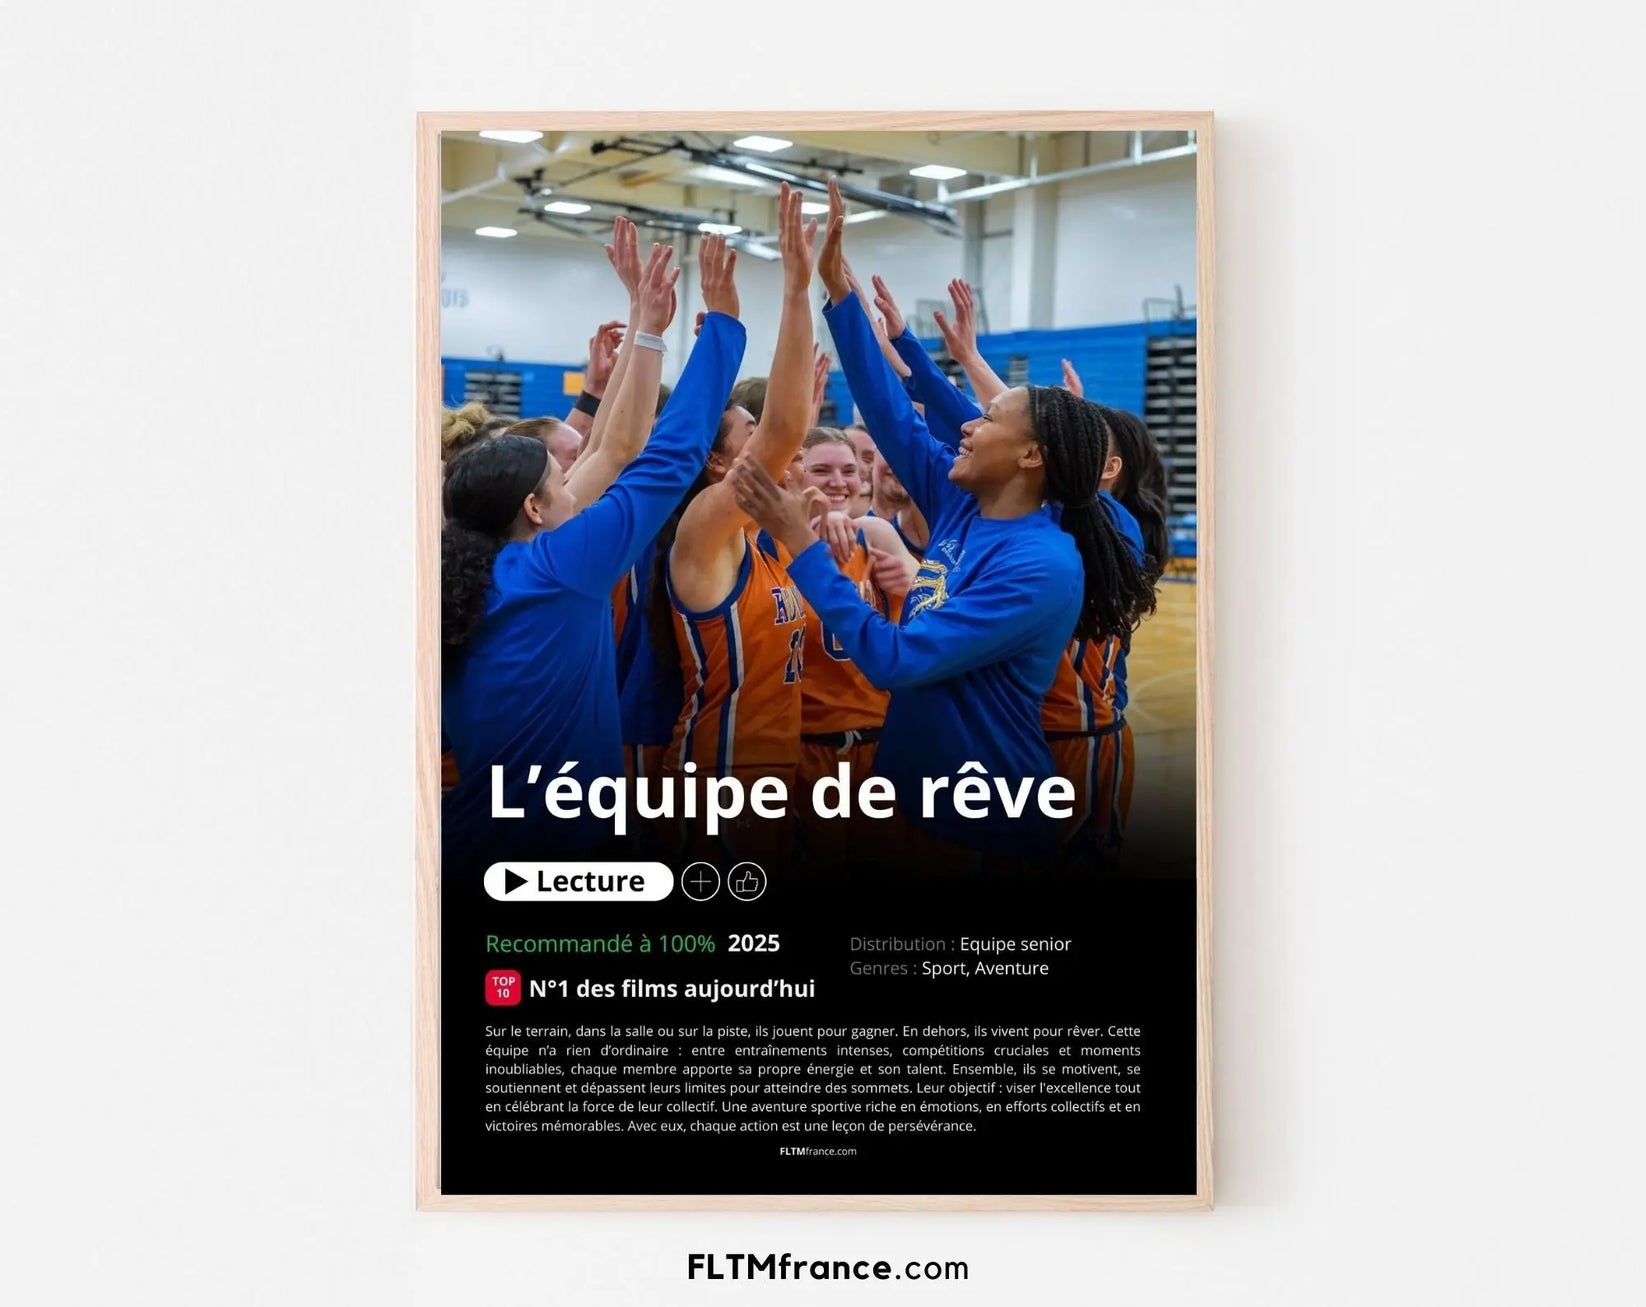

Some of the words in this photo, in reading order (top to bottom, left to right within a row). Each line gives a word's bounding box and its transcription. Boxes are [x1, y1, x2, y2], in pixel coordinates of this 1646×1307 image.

[492, 762, 787, 835] L’équipe
[813, 762, 895, 818] de
[923, 762, 1074, 818] rêve
[539, 871, 644, 892] Lecture
[487, 934, 632, 952] Recommandé
[640, 934, 650, 952] à
[660, 935, 715, 952] 100%
[728, 934, 780, 952] 2025
[851, 937, 945, 951] Distribution
[961, 937, 1015, 955] Equipe
[1021, 937, 1072, 951] senior
[850, 961, 908, 975] Genres
[922, 961, 969, 979] Sport,
[975, 961, 1049, 975] Aventure
[492, 976, 516, 986] TOP
[497, 988, 510, 998] 10
[531, 980, 567, 997] N°1
[577, 979, 615, 997] des
[622, 979, 677, 997] films
[685, 979, 814, 1002] aujourd’hui
[485, 1025, 507, 1037] Sur
[511, 1025, 522, 1037] le
[525, 1025, 571, 1038] terrain,
[575, 1024, 607, 1037] dans
[610, 1025, 621, 1037] la
[625, 1025, 654, 1037] salle
[657, 1027, 674, 1037] ou
[678, 1027, 699, 1037] sur
[702, 1025, 713, 1037] la
[717, 1025, 751, 1040] piste,
[755, 1025, 769, 1037] ils
[771, 1025, 814, 1040] jouent
[817, 1027, 848, 1040] pour
[851, 1027, 898, 1040] gagner.
[903, 1025, 918, 1037] En
[922, 1025, 970, 1039] dehors,
[974, 1025, 988, 1037] ils
[990, 1025, 1030, 1037] vivent
[1033, 1027, 1064, 1040] pour
[1067, 1024, 1104, 1037] rêver.
[1107, 1025, 1141, 1037] Cette
[485, 1044, 529, 1059] équipe
[538, 1044, 557, 1056] n’a
[566, 1044, 591, 1056] rien
[600, 1044, 669, 1057] d’ordinaire
[691, 1046, 726, 1057] entre
[734, 1044, 828, 1057] entraînements
[837, 1044, 893, 1058] intenses,
[902, 1044, 985, 1059] compétitions
[993, 1044, 1049, 1057] cruciales
[1058, 1046, 1072, 1057] et
[1081, 1046, 1141, 1057] moments
[485, 1063, 565, 1077] inoubliables,
[570, 1063, 617, 1078] chaque
[623, 1063, 677, 1075] membre
[682, 1065, 733, 1078] apporte
[738, 1065, 752, 1075] sa
[758, 1065, 801, 1078] propre
[807, 1063, 853, 1077] énergie
[859, 1064, 873, 1075] et
[878, 1065, 901, 1075] son
[906, 1063, 946, 1075] talent.
[952, 1063, 1017, 1077] Ensemble,
[1023, 1063, 1036, 1075] ils
[1041, 1065, 1056, 1075] se
[1062, 1063, 1121, 1077] motivent,
[1126, 1065, 1141, 1075] se
[485, 1082, 562, 1094] soutiennent
[565, 1083, 578, 1094] et
[581, 1082, 645, 1096] dépassent
[649, 1081, 681, 1094] leurs
[684, 1081, 727, 1094] limites
[730, 1084, 761, 1097] pour
[763, 1081, 822, 1094] atteindre
[824, 1081, 848, 1094] des
[851, 1083, 913, 1094] sommets.
[917, 1082, 945, 1094] Leur
[949, 1082, 995, 1096] objectif
[1005, 1082, 1037, 1094] viser
[1039, 1081, 1112, 1094] l'excellence
[1114, 1083, 1141, 1094] tout
[485, 1103, 501, 1113] en
[505, 1100, 565, 1113] célébrant
[568, 1100, 579, 1113] la
[582, 1100, 615, 1113] force
[618, 1100, 635, 1113] de
[638, 1100, 663, 1113] leur
[666, 1100, 718, 1113] collectif.
[722, 1101, 748, 1113] Une
[750, 1102, 808, 1113] aventure
[811, 1101, 861, 1115] sportive
[865, 1100, 897, 1113] riche
[900, 1103, 916, 1113] en
[919, 1100, 982, 1113] émotions,
[986, 1103, 1002, 1113] en
[1005, 1100, 1048, 1113] efforts
[1050, 1100, 1106, 1113] collectifs
[1108, 1102, 1122, 1113] et
[1125, 1103, 1141, 1113] en
[485, 1120, 538, 1132] victoires
[541, 1119, 624, 1132] mémorables.
[627, 1120, 657, 1132] Avec
[660, 1122, 687, 1133] eux,
[691, 1120, 736, 1134] chaque
[739, 1120, 778, 1132] action
[781, 1121, 801, 1132] est
[804, 1122, 829, 1132] une
[833, 1120, 864, 1134] leçon
[868, 1119, 885, 1132] de
[889, 1120, 976, 1134] persévérance.
[779, 1146, 857, 1156] FLTMfrance.com
